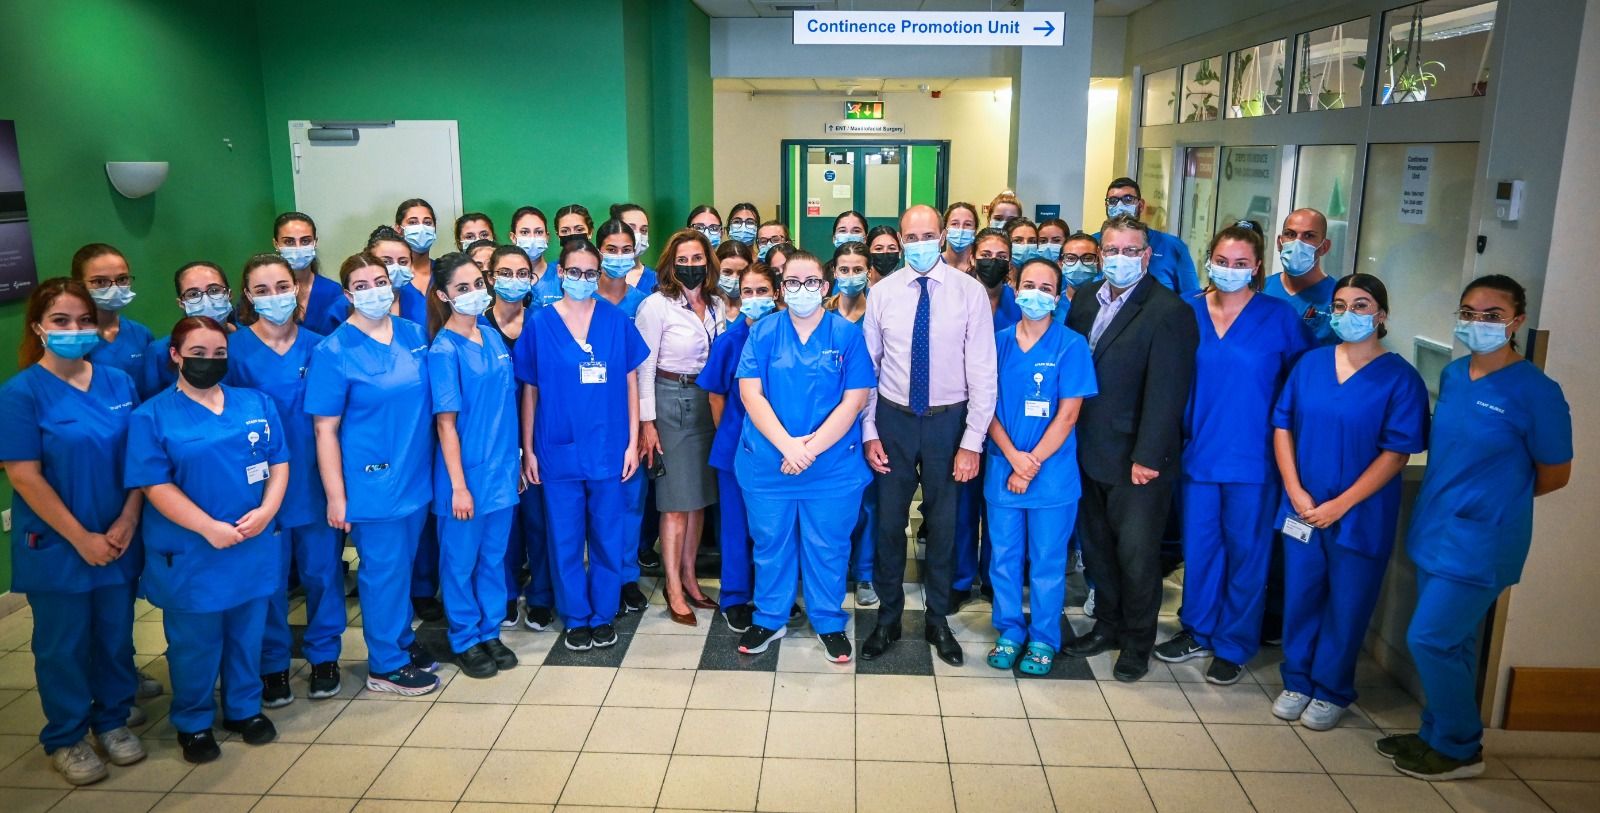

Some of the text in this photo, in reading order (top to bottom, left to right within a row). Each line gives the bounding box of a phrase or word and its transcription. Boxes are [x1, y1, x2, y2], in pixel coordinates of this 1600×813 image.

[807, 19, 1020, 34] Continence Promotion Unit
